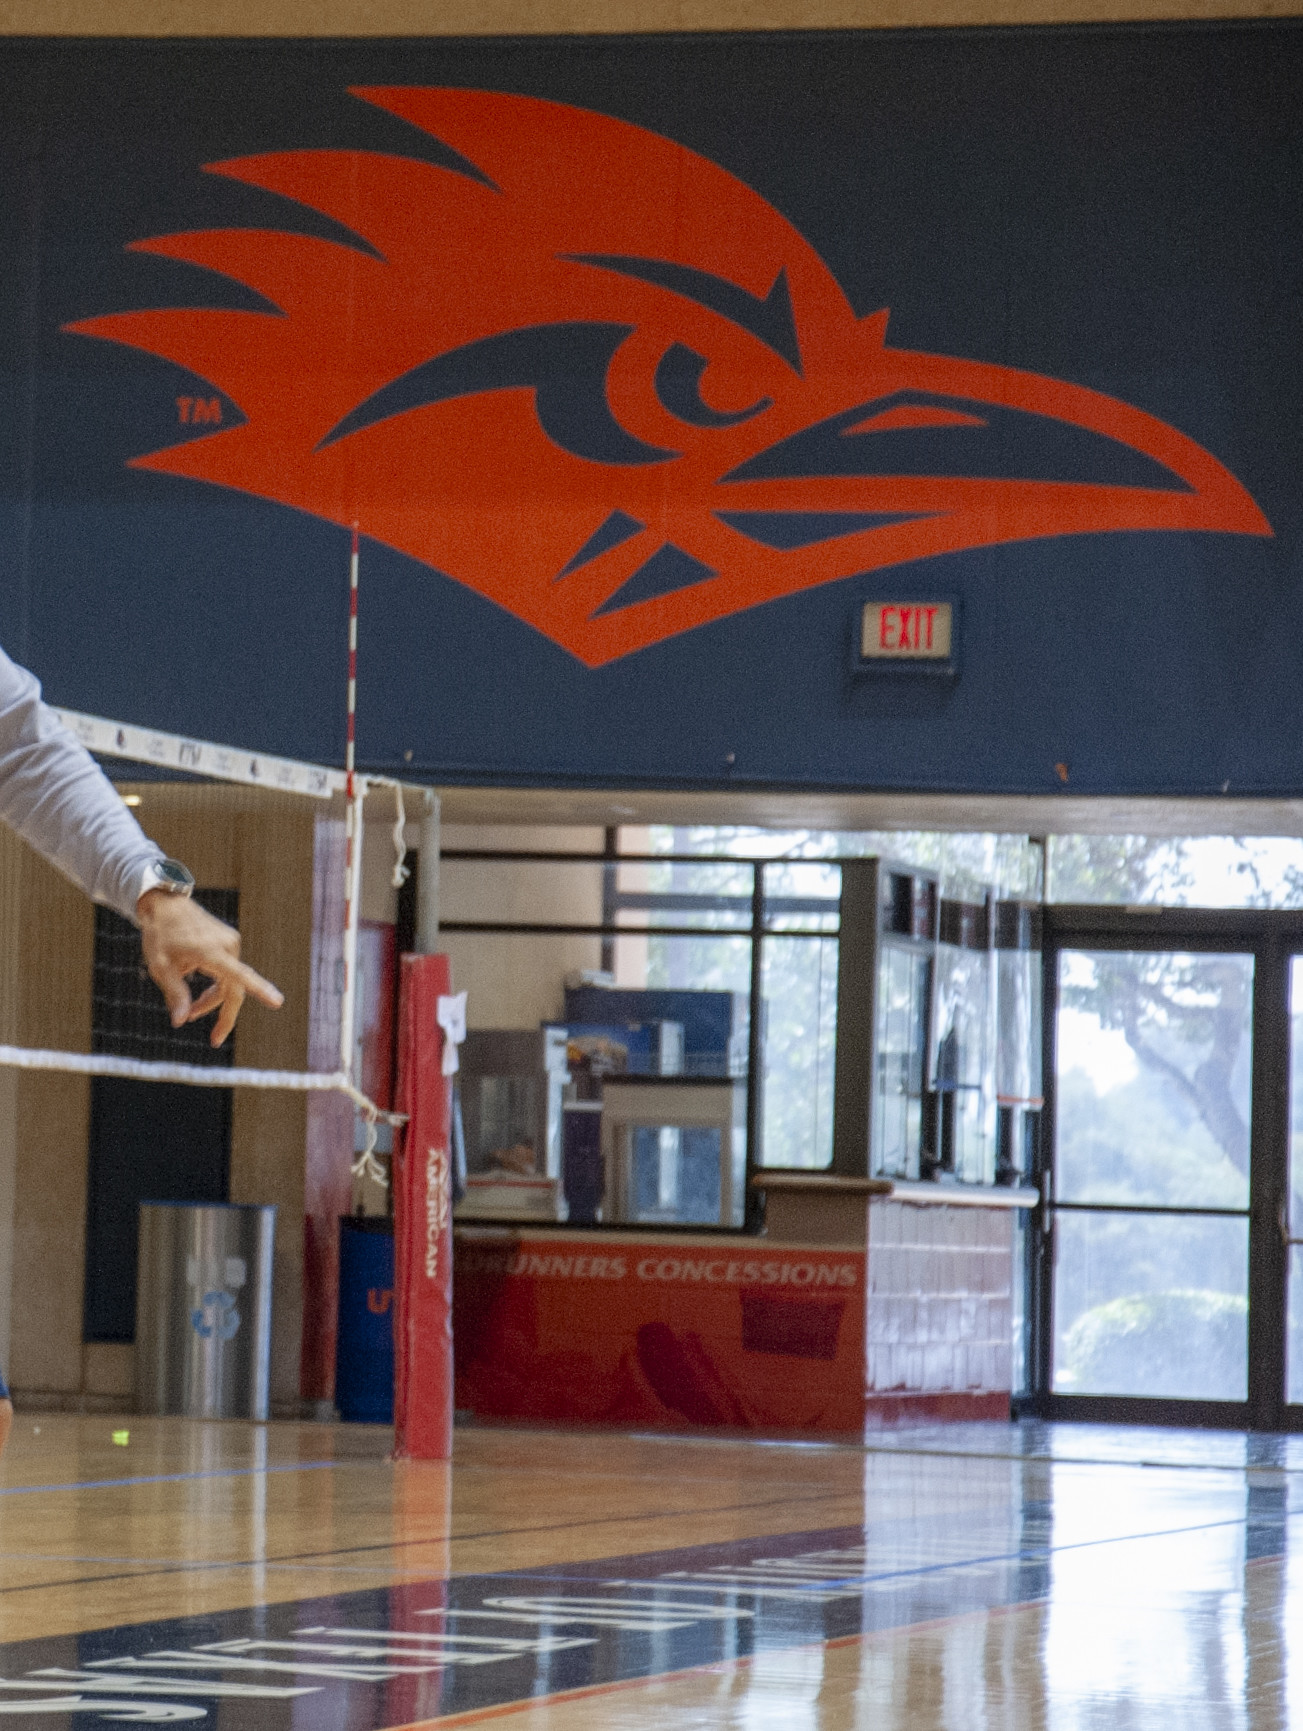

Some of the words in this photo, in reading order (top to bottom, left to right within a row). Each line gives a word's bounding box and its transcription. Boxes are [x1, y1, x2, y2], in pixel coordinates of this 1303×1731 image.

[176, 396, 222, 423] TM
[879, 606, 939, 650] EXIT
[635, 1258, 859, 1287] CONCESSIONS
